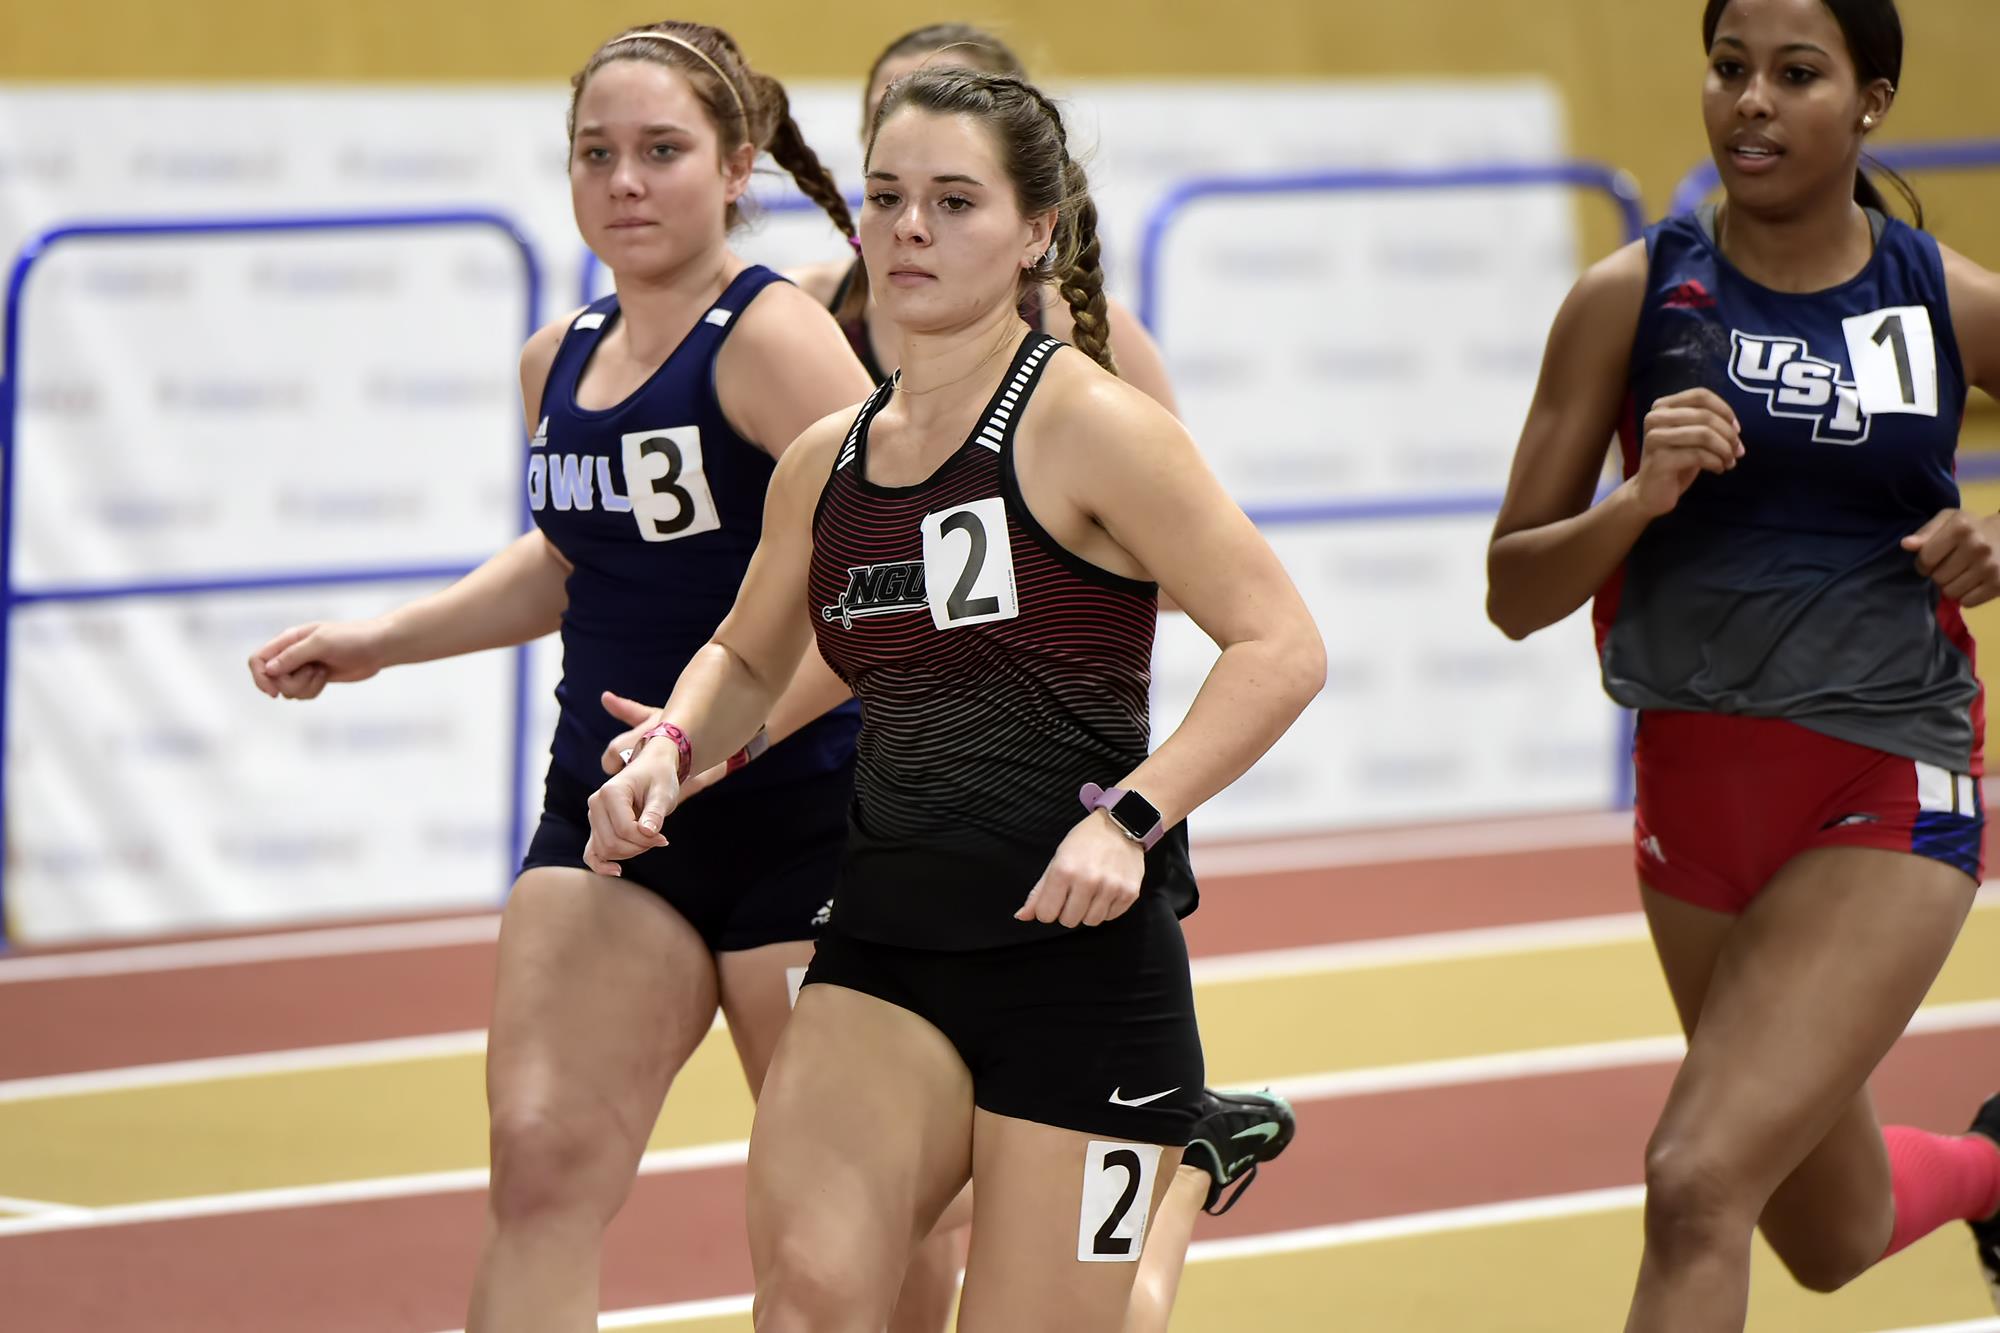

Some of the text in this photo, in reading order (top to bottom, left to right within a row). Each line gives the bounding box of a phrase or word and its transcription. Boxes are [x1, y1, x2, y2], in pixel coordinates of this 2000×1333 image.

[1870, 314, 1916, 406] 1
[639, 436, 696, 534] 3
[844, 562, 928, 606] NGU
[939, 510, 1000, 621] 2
[1092, 1148, 1142, 1255] 2
